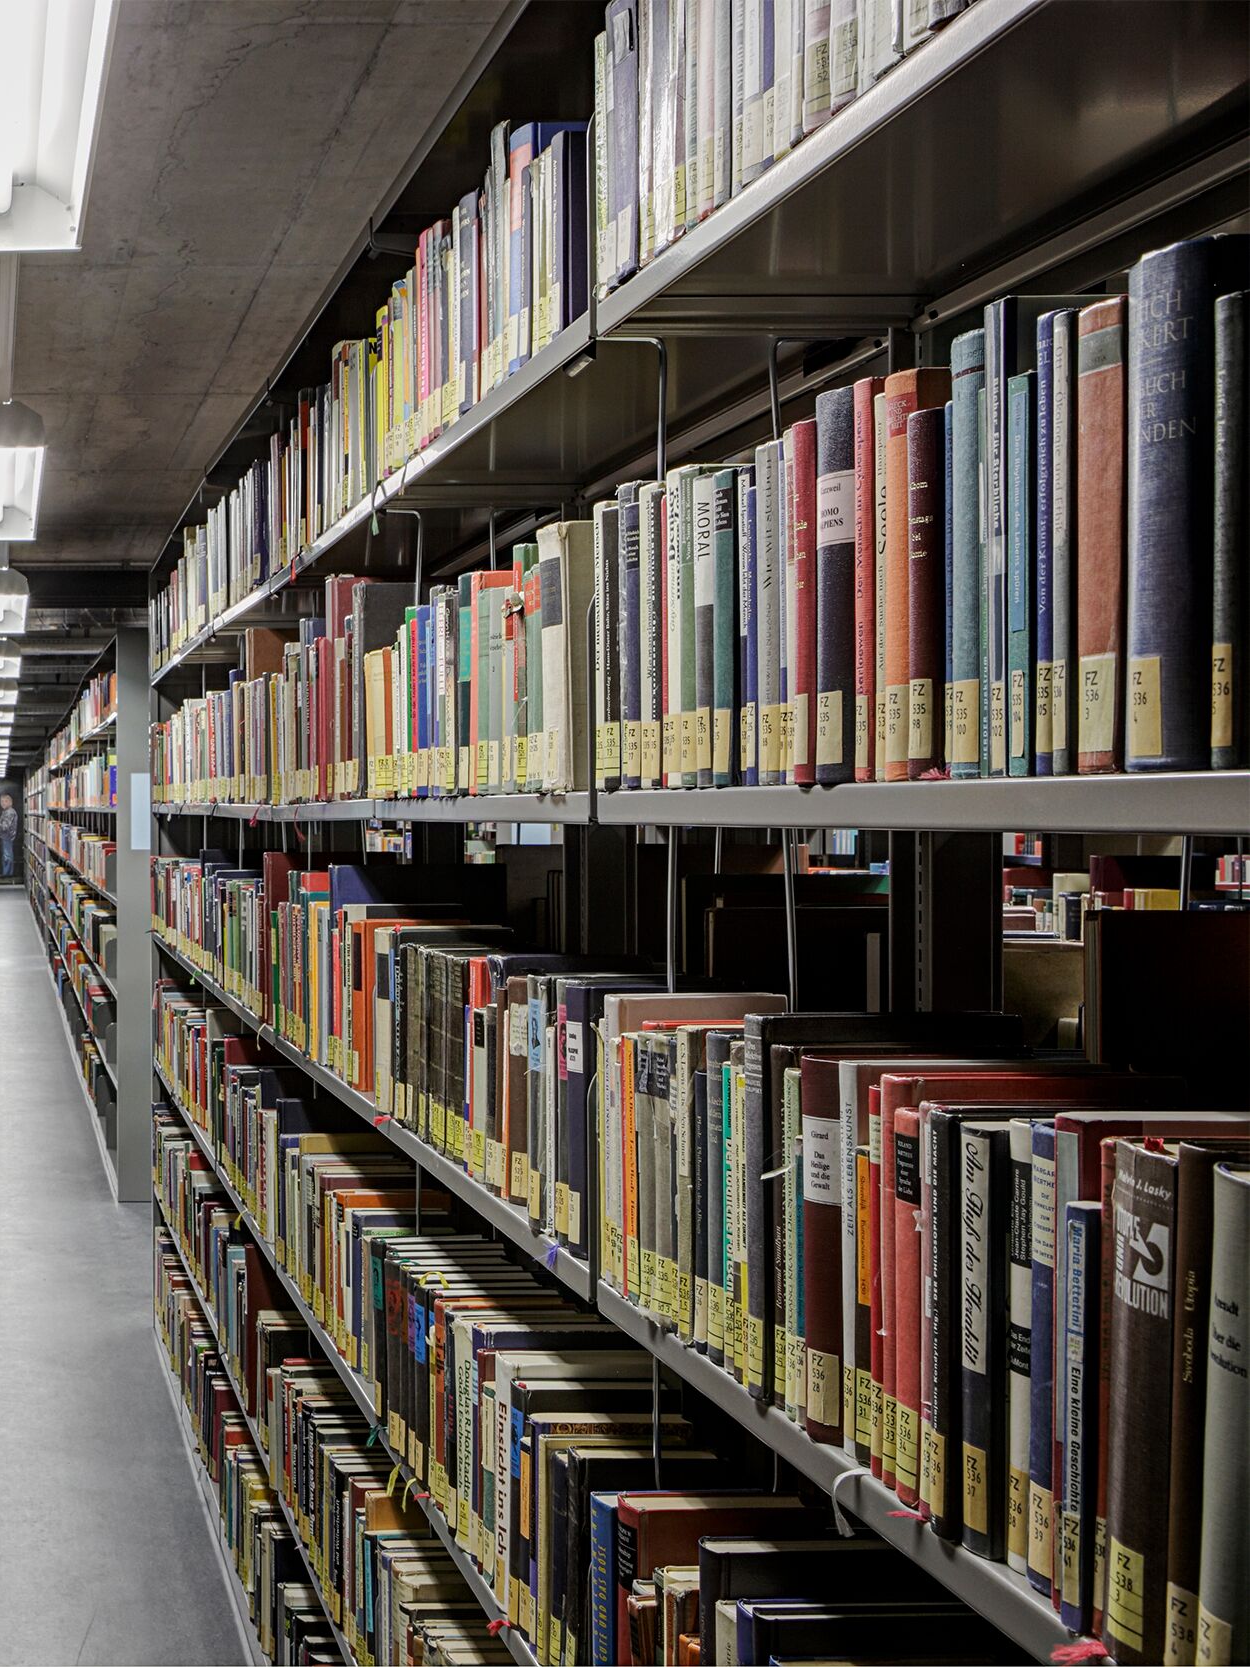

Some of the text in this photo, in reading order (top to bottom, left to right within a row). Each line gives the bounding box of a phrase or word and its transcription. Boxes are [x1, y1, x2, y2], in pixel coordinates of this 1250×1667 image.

[817, 71, 828, 83] 52
[855, 411, 864, 491] Cyberspace
[1054, 463, 1064, 490] und
[1038, 380, 1047, 614] Von der Kunst, erfolgreich zu leben
[1054, 498, 1064, 534] Ethik
[668, 488, 676, 560] Denker
[697, 502, 711, 561] MORAL
[1053, 665, 1065, 679] FZ
[1213, 658, 1225, 672] FZ
[1012, 674, 1023, 688] FZ
[1039, 667, 1051, 681] FZ
[1085, 671, 1098, 686] FZ
[1133, 672, 1142, 685] FZ
[912, 684, 925, 697] FZ
[992, 688, 1001, 701] FZ
[1038, 686, 1049, 699] 535
[1085, 689, 1099, 702] 536
[1213, 682, 1230, 696] 536
[820, 696, 829, 708] FZ
[889, 693, 898, 705] FZ
[956, 691, 964, 703] FZ
[1133, 692, 1147, 705] 536
[912, 703, 926, 716] 535
[1085, 707, 1090, 720] 3
[912, 719, 921, 729] 98
[956, 723, 967, 735] 100
[810, 1130, 829, 1140] Girard
[845, 1101, 853, 1182] LEBENSKUNST
[814, 1151, 825, 1160] Das
[965, 1142, 984, 1183] Am
[810, 1160, 830, 1171] Heilige
[820, 1171, 831, 1181] die
[810, 1180, 830, 1191] Gewalt
[1136, 1179, 1143, 1192] J.
[1143, 1181, 1172, 1201] Lasky
[846, 1213, 854, 1236] ZEIT
[1019, 1179, 1027, 1261] Stephen Jay Gould
[965, 1241, 981, 1272] des
[1072, 1226, 1083, 1328] Maria Bettetini
[1115, 1275, 1169, 1320] REVOLUTION
[961, 1277, 982, 1366] Heraklit
[1183, 1270, 1199, 1383] Swoboda Utopia
[797, 1340, 806, 1353] FZ
[1225, 1335, 1242, 1352] die
[812, 1354, 823, 1367] FZ
[812, 1368, 825, 1381] 536
[463, 1360, 472, 1414] Douglas
[812, 1382, 820, 1393] 28
[860, 1377, 871, 1390] FZ
[872, 1384, 882, 1399] FZ
[859, 1393, 871, 1406] 536
[859, 1406, 866, 1417] 31
[872, 1401, 883, 1414] 536
[886, 1401, 896, 1414] FZ
[872, 1416, 878, 1427] 32
[901, 1411, 910, 1425] FZ
[885, 1430, 895, 1442] 33
[900, 1425, 911, 1440] 536
[1071, 1366, 1081, 1512] Eine kleine Geschichte
[900, 1440, 907, 1452] 34
[967, 1455, 977, 1471] FZ
[498, 1401, 508, 1555] Einsicht ins Ich
[967, 1468, 981, 1484] 536
[1010, 1475, 1020, 1491] FZ
[967, 1486, 976, 1497] 37
[1009, 1497, 1022, 1515] 536
[1033, 1493, 1043, 1510] FZ
[1034, 1511, 1049, 1529] 536
[1064, 1518, 1079, 1536] FZ
[1034, 1528, 1043, 1542] 39
[1063, 1536, 1076, 1552] 536
[1064, 1555, 1072, 1569] 41
[1117, 1552, 1131, 1571] FZ
[1116, 1572, 1133, 1592] 538
[1115, 1589, 1120, 1602] 3
[598, 1545, 607, 1662] GUTE UND DAS BÖSE
[1171, 1597, 1188, 1617] FZ
[1171, 1623, 1194, 1643] 538
